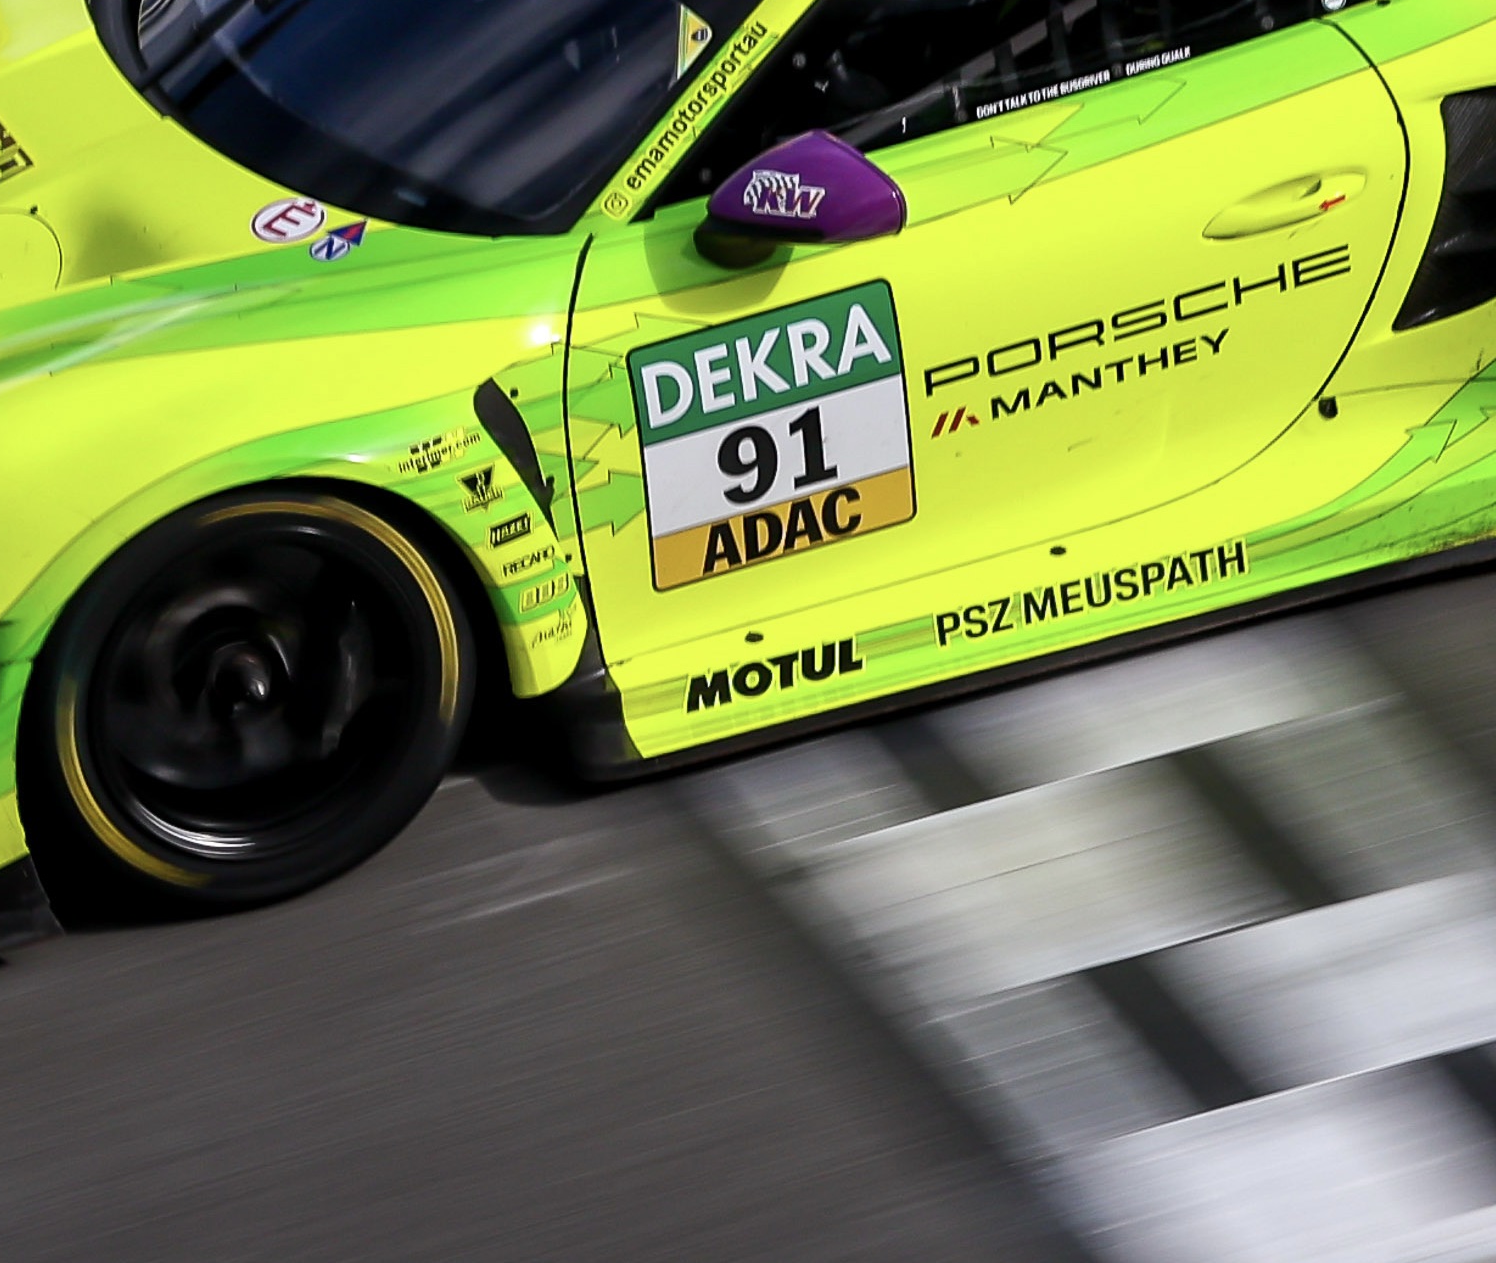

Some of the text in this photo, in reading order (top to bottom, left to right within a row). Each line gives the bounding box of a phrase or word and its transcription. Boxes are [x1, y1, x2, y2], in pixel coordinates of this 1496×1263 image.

[625, 19, 768, 191] emamotorsportau
[641, 303, 893, 430] DEKRA
[923, 243, 1351, 398] PORSCHE
[990, 328, 1230, 421] MANTHEY
[716, 405, 839, 505] 91
[702, 487, 864, 576] ADAC
[685, 540, 1248, 715] MOTUL PSZ MEUSPATH
